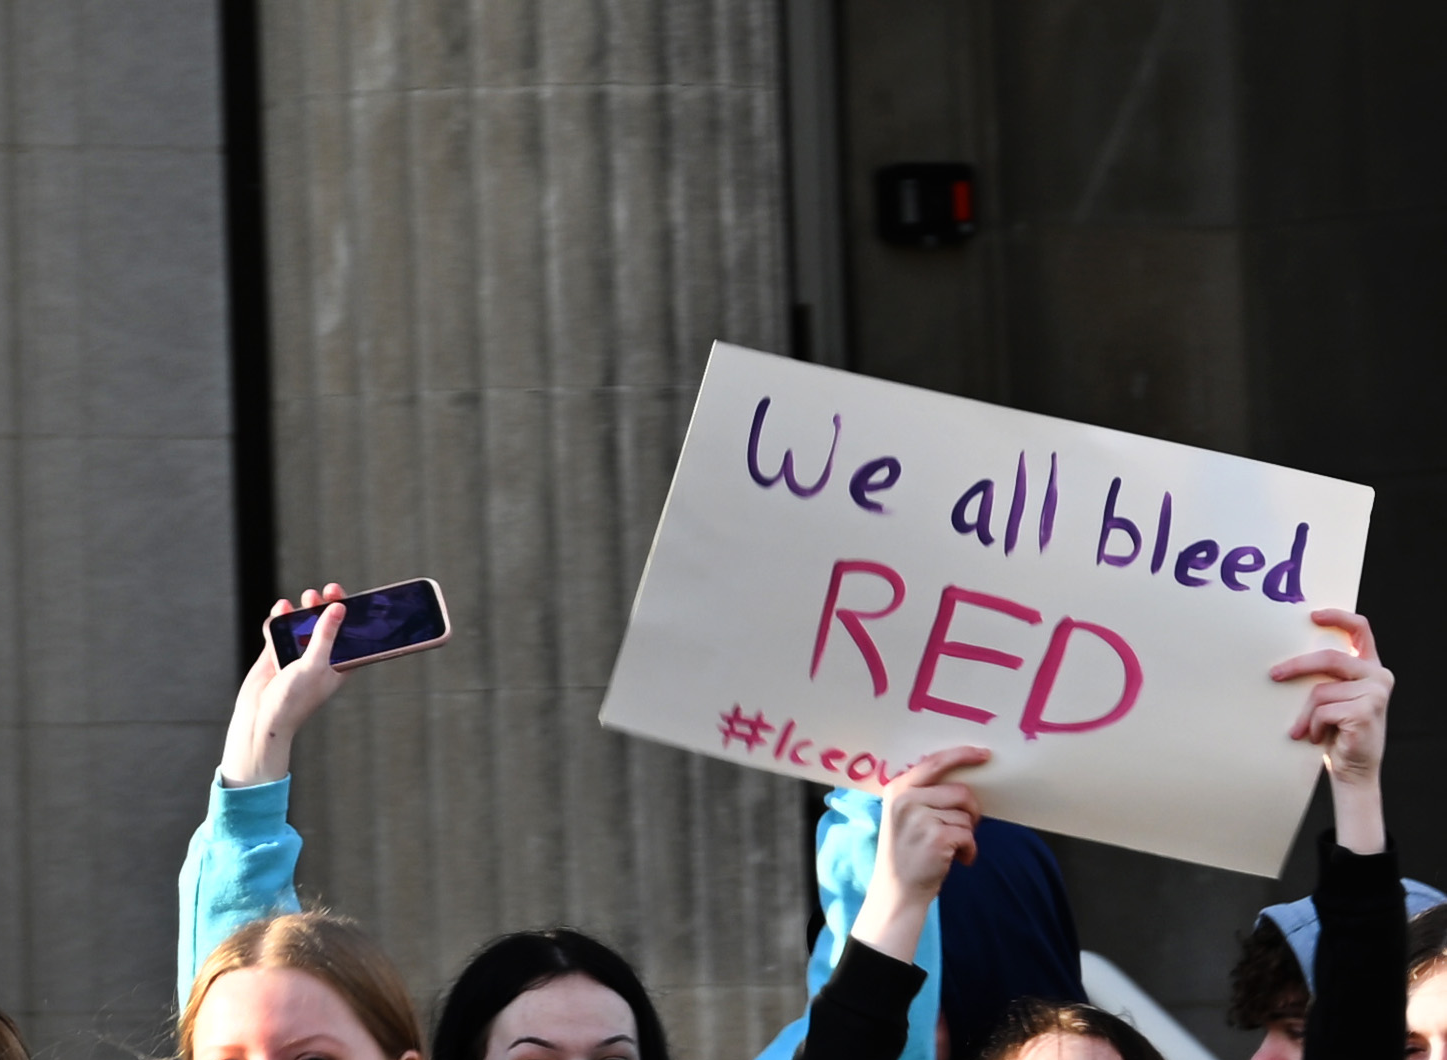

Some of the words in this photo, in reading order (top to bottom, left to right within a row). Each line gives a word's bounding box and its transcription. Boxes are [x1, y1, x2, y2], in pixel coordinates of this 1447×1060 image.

[746, 396, 903, 516] We
[950, 449, 1059, 558] all
[1095, 476, 1311, 604] bleed
[808, 558, 1145, 742] RED
